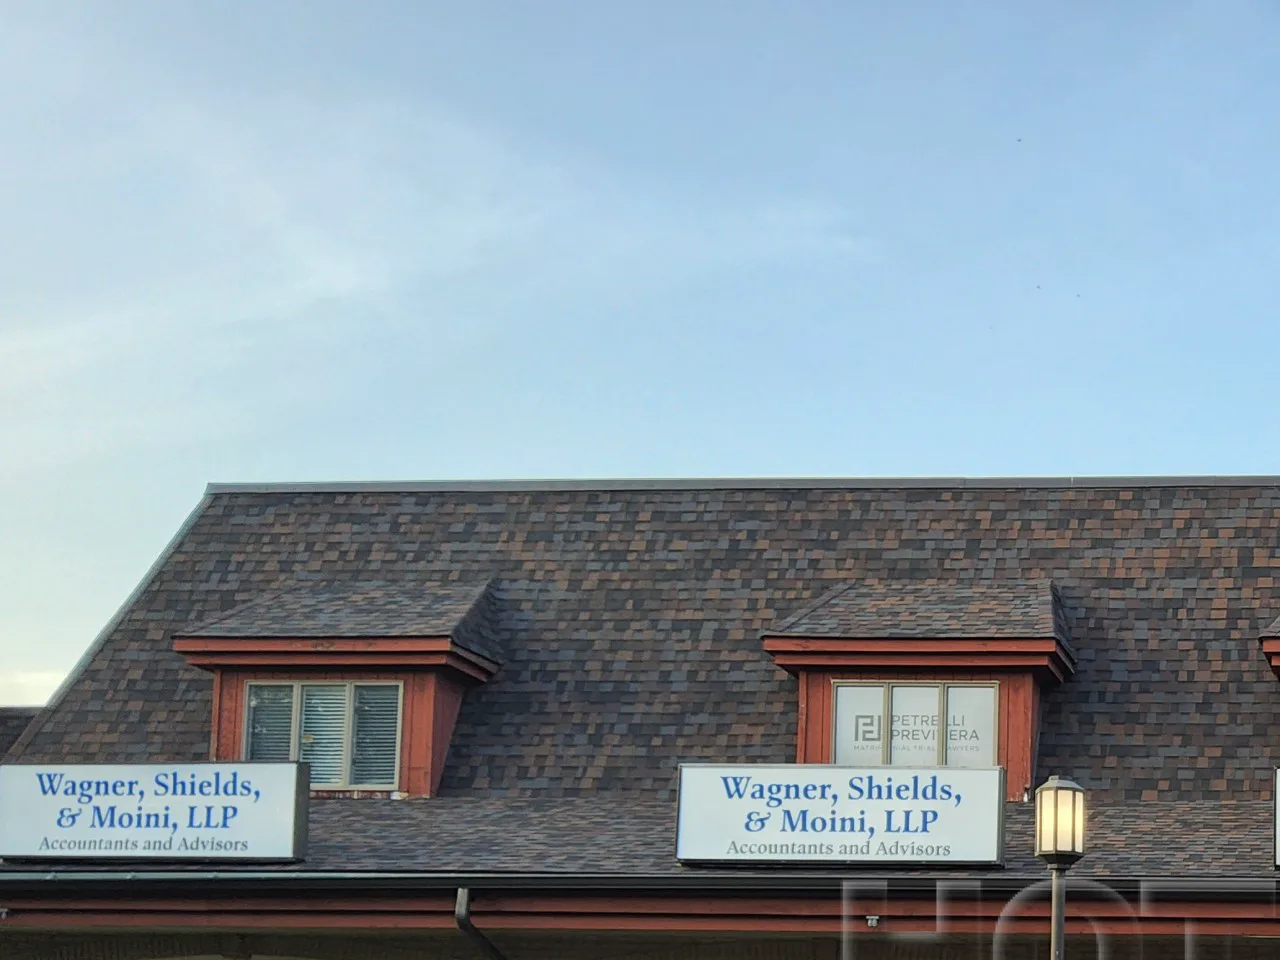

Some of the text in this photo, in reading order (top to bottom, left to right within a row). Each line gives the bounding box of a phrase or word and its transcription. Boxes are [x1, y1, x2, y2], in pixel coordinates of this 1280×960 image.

[892, 729, 980, 741] PREVIERA
[36, 771, 261, 804] Wagner, Shields,
[720, 775, 962, 808] Wagner, Shields,
[56, 805, 238, 834] & Moini, LLP
[744, 809, 939, 839] & Moini, LLP
[39, 836, 249, 851] Accountants and Advisors
[726, 840, 951, 856] Accountants and Advisors
